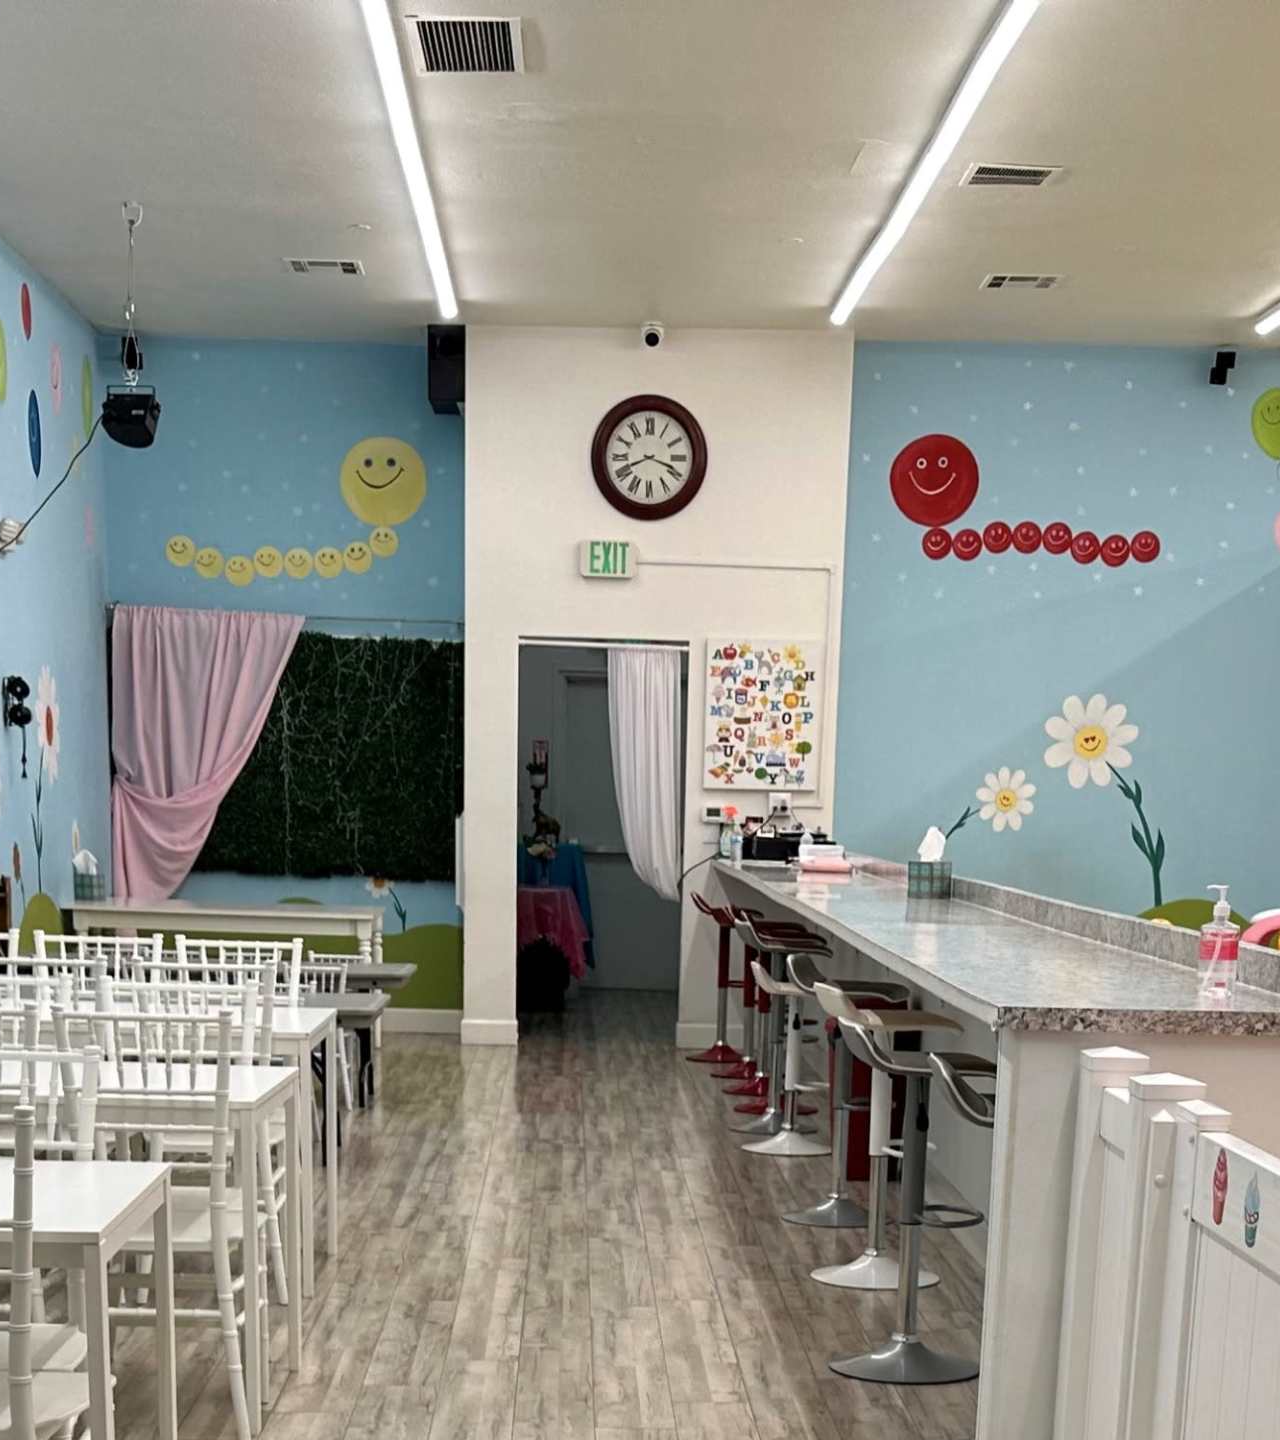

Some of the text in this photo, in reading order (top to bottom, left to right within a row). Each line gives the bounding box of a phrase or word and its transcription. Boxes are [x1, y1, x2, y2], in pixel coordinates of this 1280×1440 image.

[590, 540, 629, 574] EXIT
[712, 649, 723, 660] A
[744, 660, 754, 670] B
[804, 671, 815, 681] H
[759, 680, 770, 691] F
[726, 688, 733, 700] I
[770, 701, 781, 712] K
[800, 696, 810, 708] L
[710, 705, 721, 716] M
[753, 712, 763, 722] N
[782, 712, 792, 725] O
[803, 712, 813, 724] P
[734, 727, 745, 742] Q
[785, 729, 794, 741] S
[723, 745, 734, 758] U
[755, 753, 765, 764] V
[788, 758, 800, 768] W
[724, 773, 734, 784] X
[769, 773, 778, 785] Y
